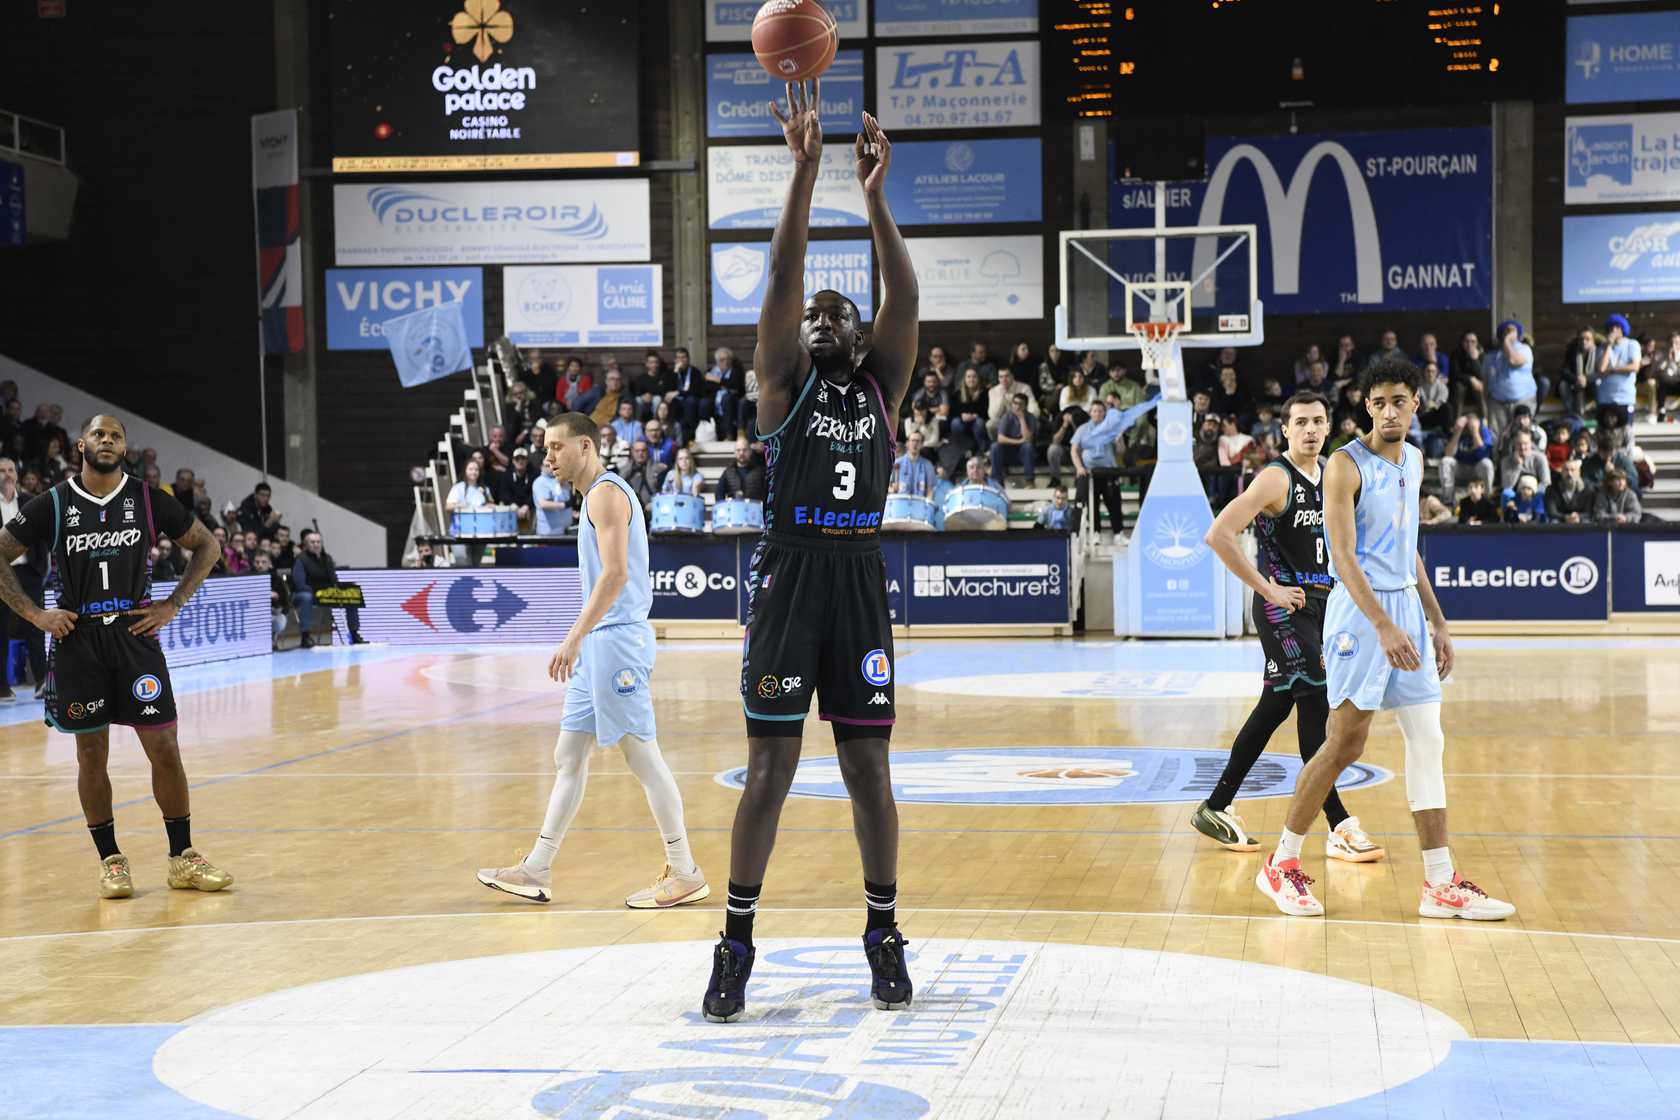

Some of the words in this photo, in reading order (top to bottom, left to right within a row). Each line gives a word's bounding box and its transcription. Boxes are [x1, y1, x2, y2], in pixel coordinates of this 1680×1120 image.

[1609, 43, 1673, 63] HOME
[432, 63, 536, 91] Golden
[445, 91, 526, 115] palace
[717, 99, 771, 117] Crédit
[922, 93, 1027, 109] Maçonnerie
[462, 115, 508, 127] CASINO
[1641, 134, 1667, 152] La
[745, 151, 832, 166] TRANSS
[1366, 154, 1478, 180] ST-POURÇAIN
[716, 167, 753, 183] DÔME
[759, 167, 860, 182] DISTUTION
[914, 174, 959, 185] ATELIER
[960, 172, 1005, 184] LACOUR
[1122, 188, 1192, 209] s/ALIER
[395, 204, 581, 225] DUCLEROIR
[804, 254, 868, 269] rasseurs
[1388, 263, 1476, 290] GANNAT
[335, 279, 473, 311] VICHY
[833, 461, 856, 500] 3
[794, 506, 881, 527] E.Leclerc
[1293, 509, 1323, 528] PERIG
[66, 528, 141, 555] PERIGORD
[1316, 537, 1323, 564] 8
[99, 562, 109, 590] 1
[707, 573, 736, 591] Co
[1296, 570, 1332, 586] E.Lecler
[1435, 566, 1557, 587] E.Leclerc
[946, 578, 1048, 596] Machuret
[166, 580, 249, 650] refour
[782, 676, 802, 693] gie
[861, 953, 1027, 1066] MUTUELLE
